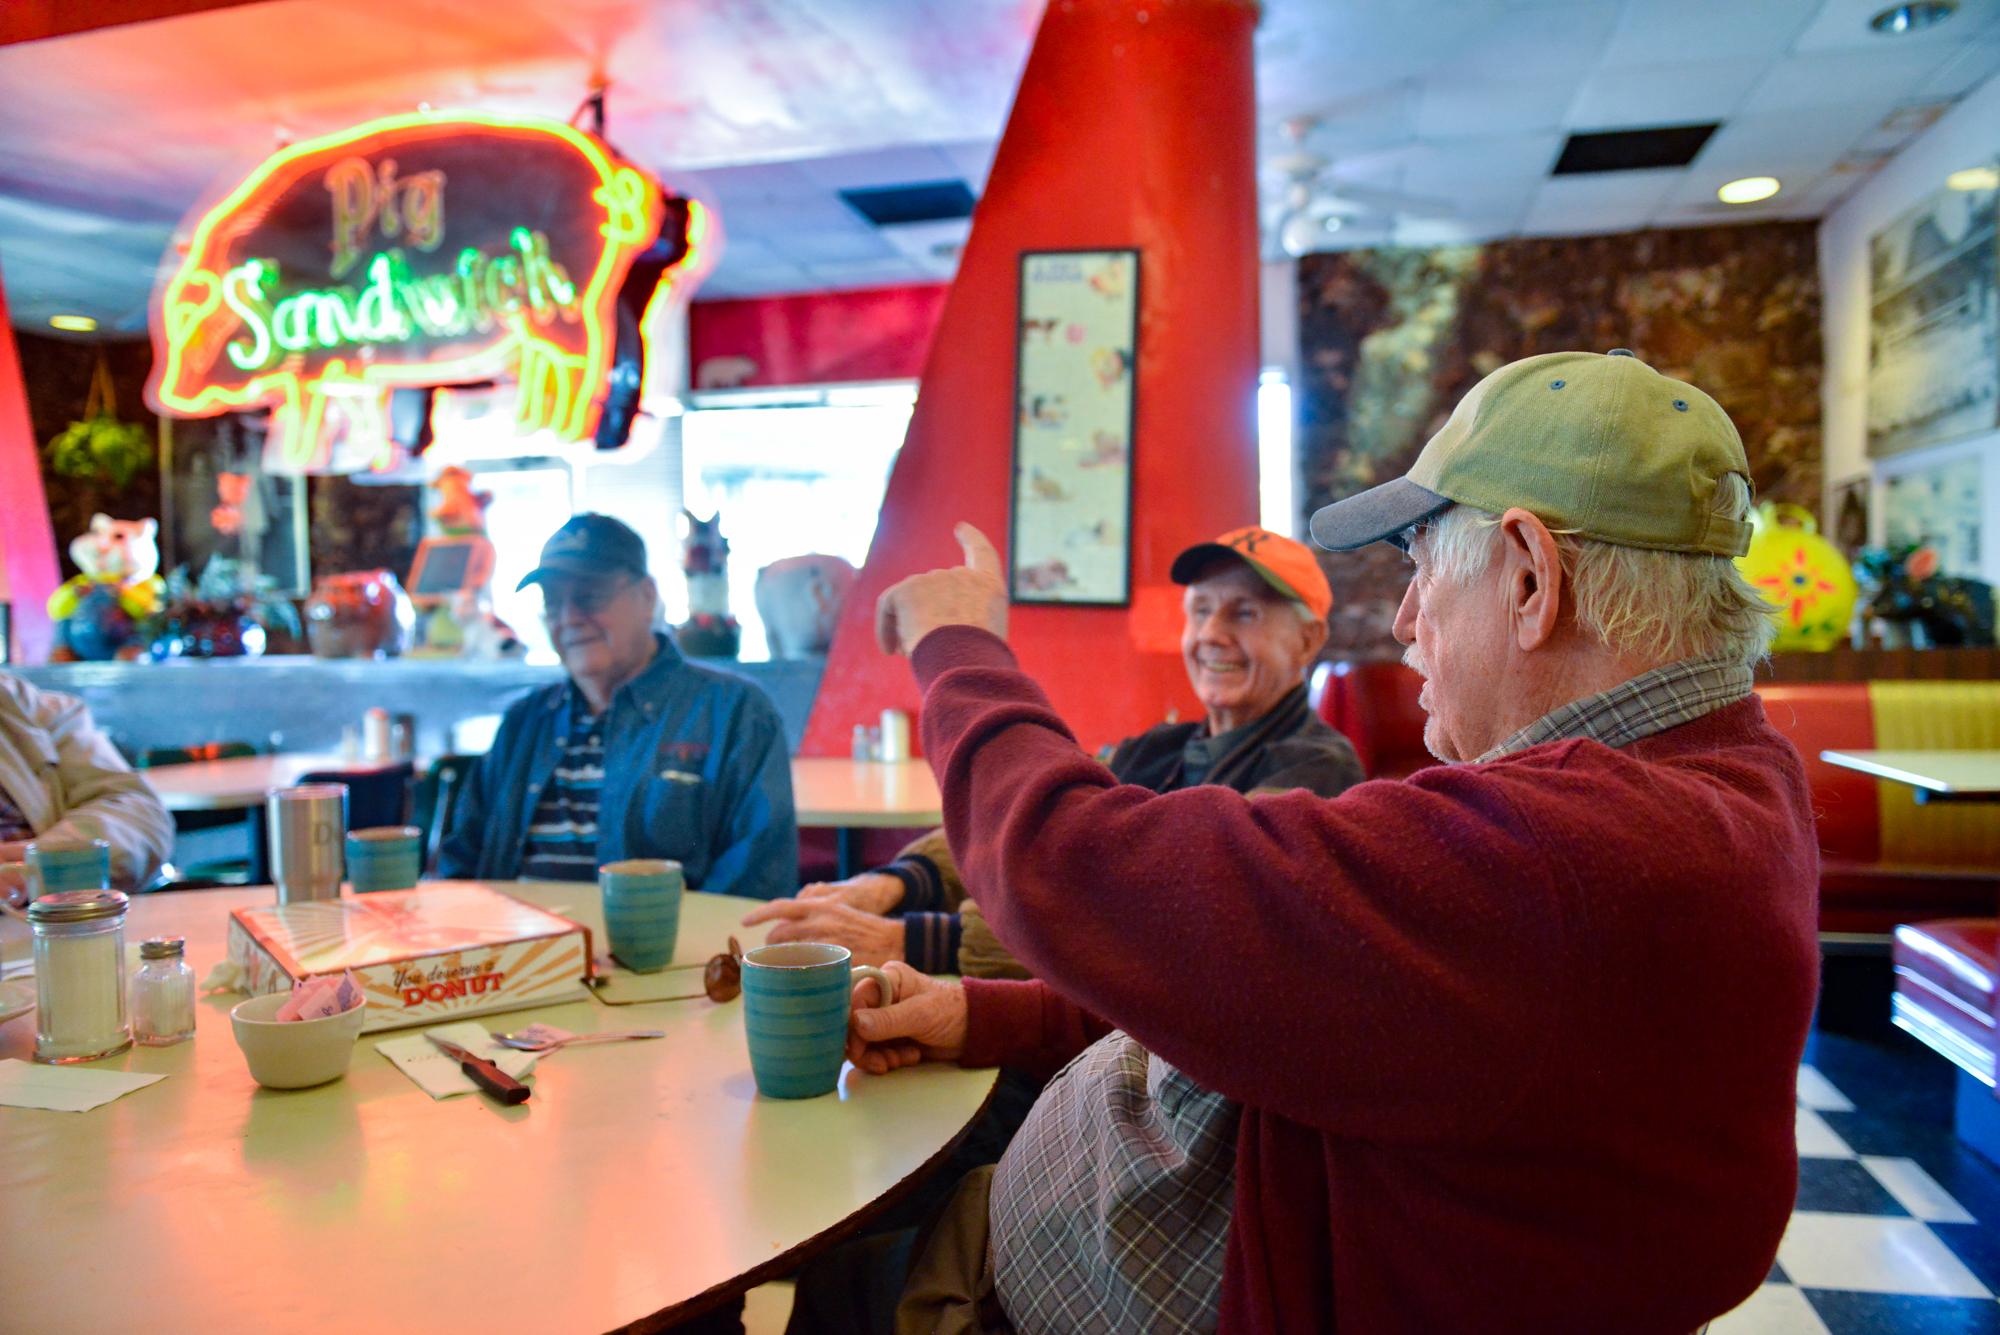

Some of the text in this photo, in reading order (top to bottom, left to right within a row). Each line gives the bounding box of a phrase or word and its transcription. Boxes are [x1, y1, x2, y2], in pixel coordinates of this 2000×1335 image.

[222, 226, 576, 369] Sandwich
[393, 968, 422, 994] You
[427, 964, 481, 982] deserve
[403, 972, 504, 1007] DONUT
